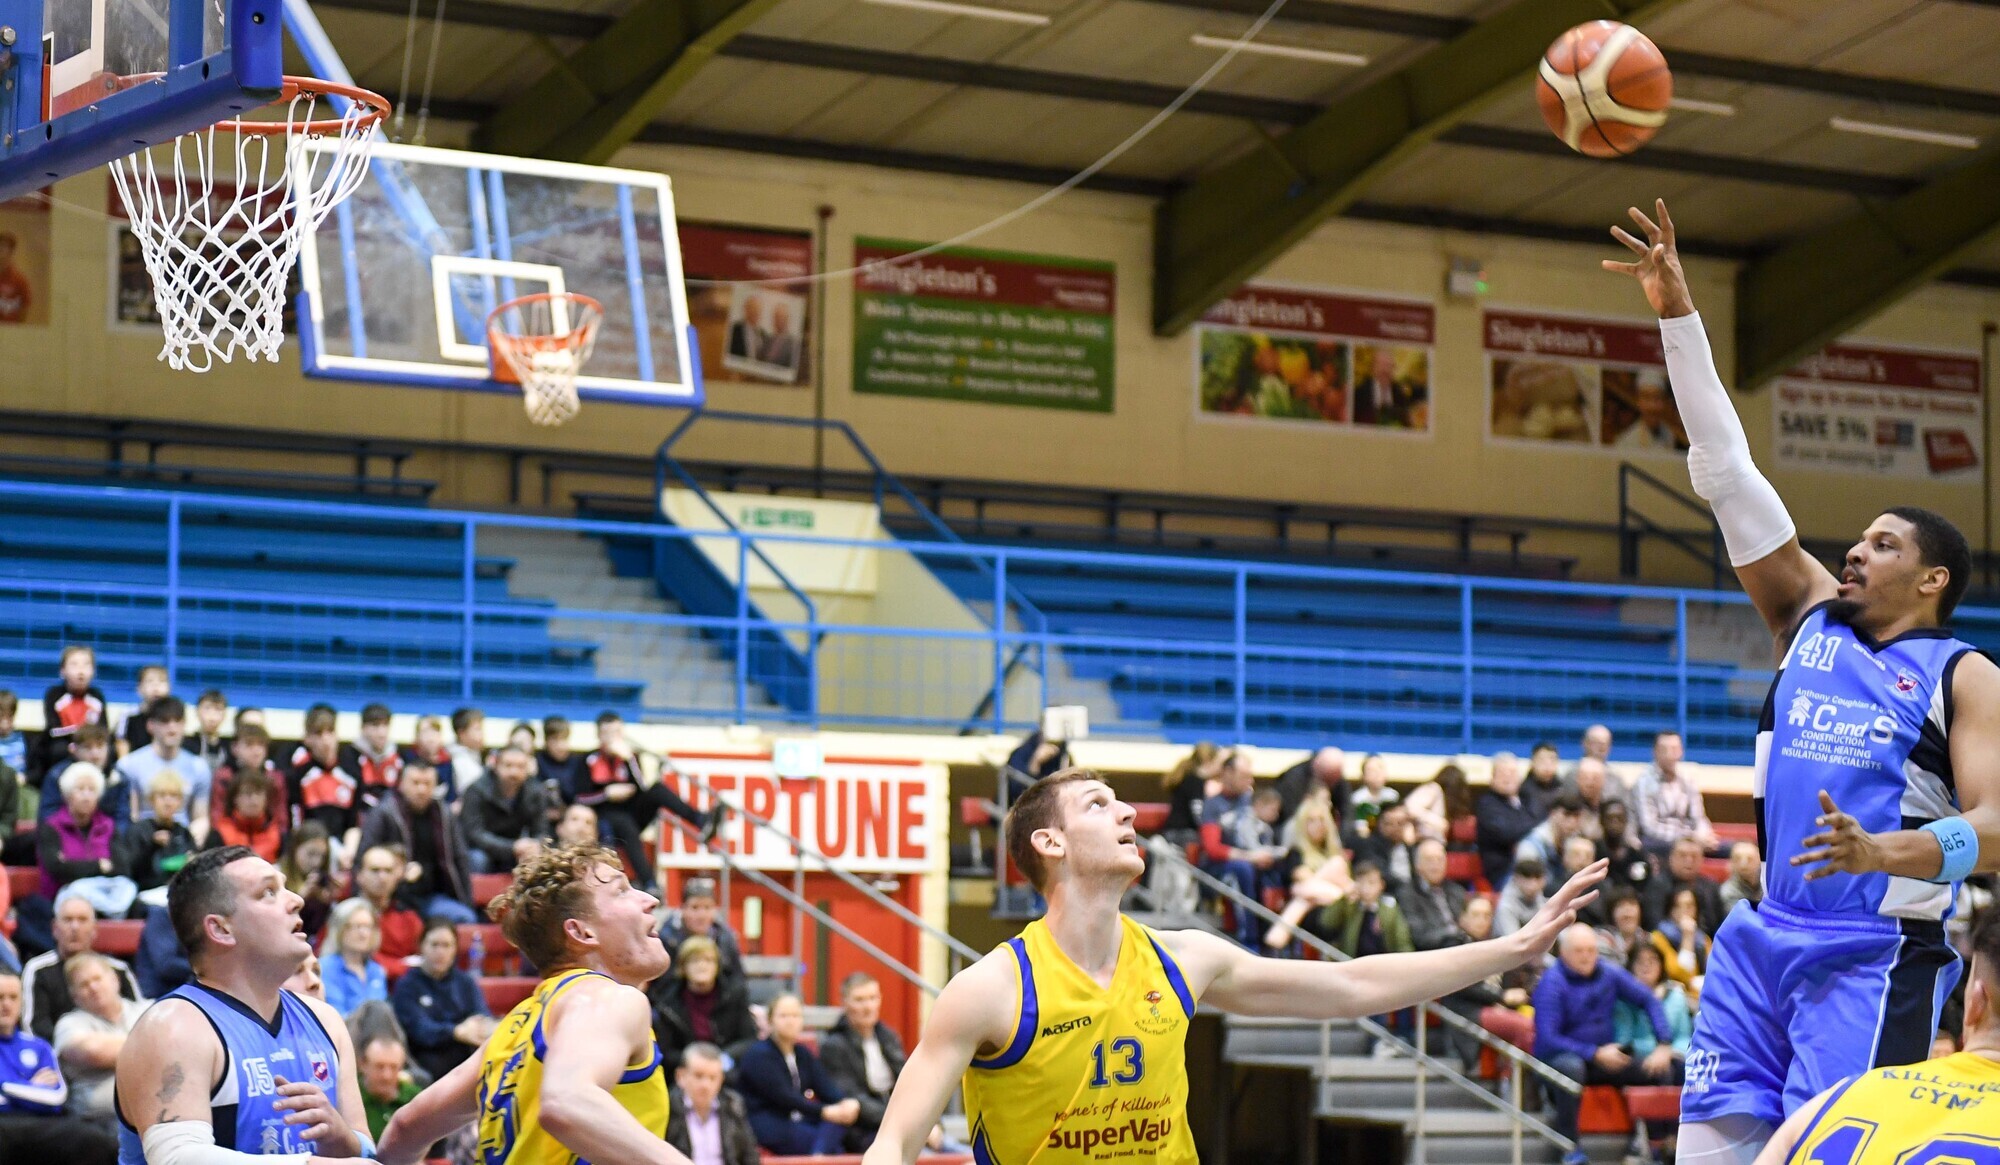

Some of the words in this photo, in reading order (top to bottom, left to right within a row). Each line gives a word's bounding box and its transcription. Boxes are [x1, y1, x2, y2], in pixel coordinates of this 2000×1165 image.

[1780, 411, 1829, 437] SAVE
[1797, 632, 1842, 672] 41
[1795, 687, 1830, 704] Anthony
[1832, 695, 1872, 710] Coughlan
[1812, 704, 1837, 733] C
[1833, 722, 1869, 738] and
[1869, 715, 1899, 745] S
[1792, 738, 1808, 748] GAS
[1818, 743, 1833, 754] OIL
[1834, 745, 1872, 760] HEATING
[1801, 729, 1866, 747] CONSTRUCTION
[1781, 747, 1833, 764] INSULATION
[1829, 754, 1882, 771] SPECIALISTS
[660, 773, 926, 860] NEPTUNE
[1089, 1036, 1145, 1089] 13
[241, 1057, 275, 1098] 15
[1101, 1098, 1119, 1122] of
